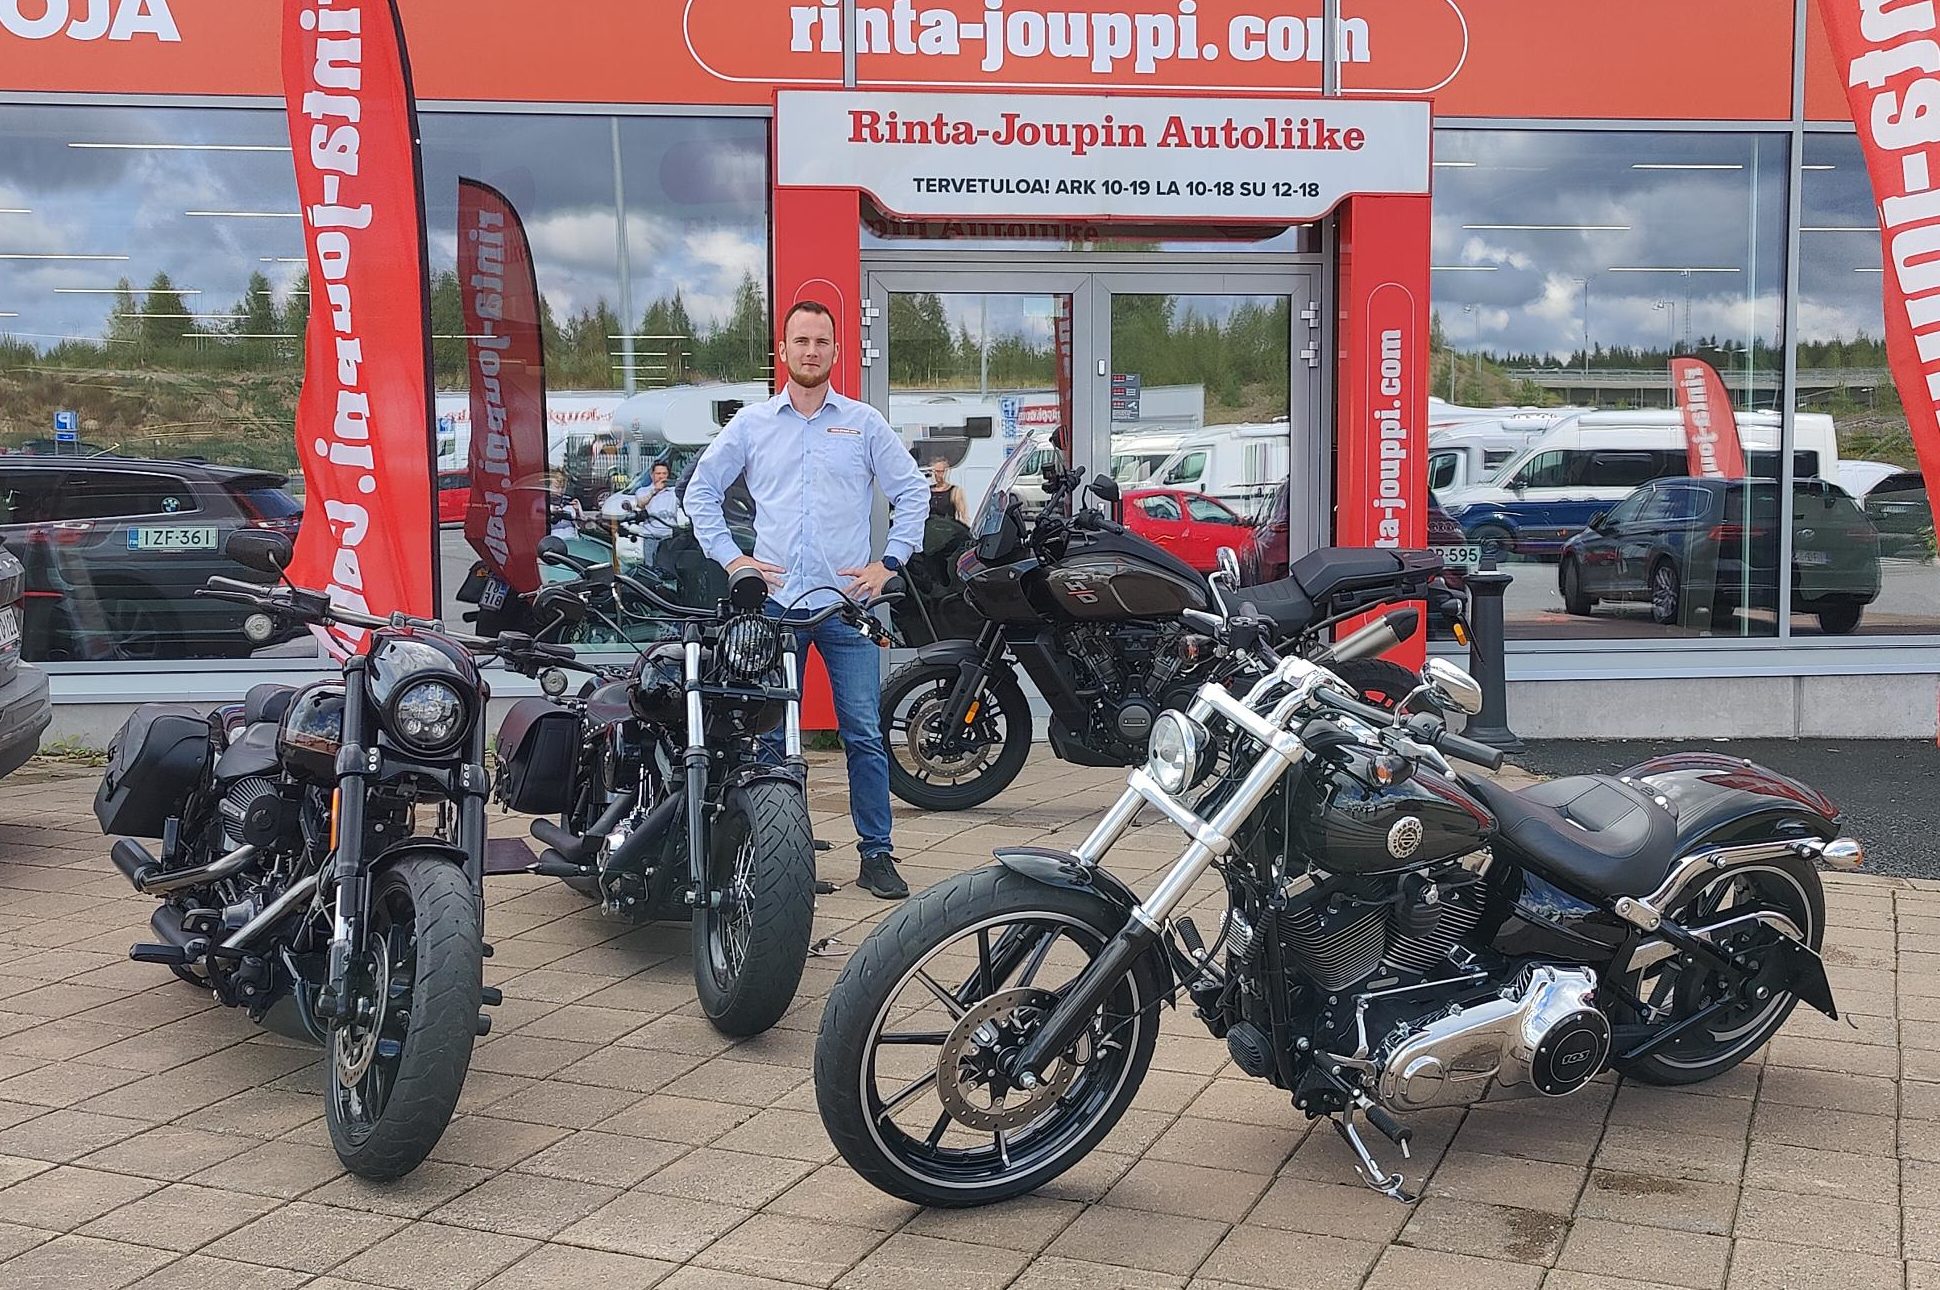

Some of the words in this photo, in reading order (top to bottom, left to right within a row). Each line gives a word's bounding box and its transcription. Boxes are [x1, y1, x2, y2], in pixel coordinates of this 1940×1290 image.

[789, 0, 1371, 73] rinta-jouppi.com
[847, 110, 1147, 156] Rinta-Joupin
[1157, 116, 1366, 150] Autoliike
[913, 177, 1050, 195] TERVETULOA!
[1055, 179, 1096, 195] ARK
[1101, 179, 1151, 196] 10-19
[1156, 180, 1180, 196] LA
[1186, 181, 1235, 197] 10-18
[1239, 181, 1266, 197] SU
[1272, 182, 1320, 198] 12-18
